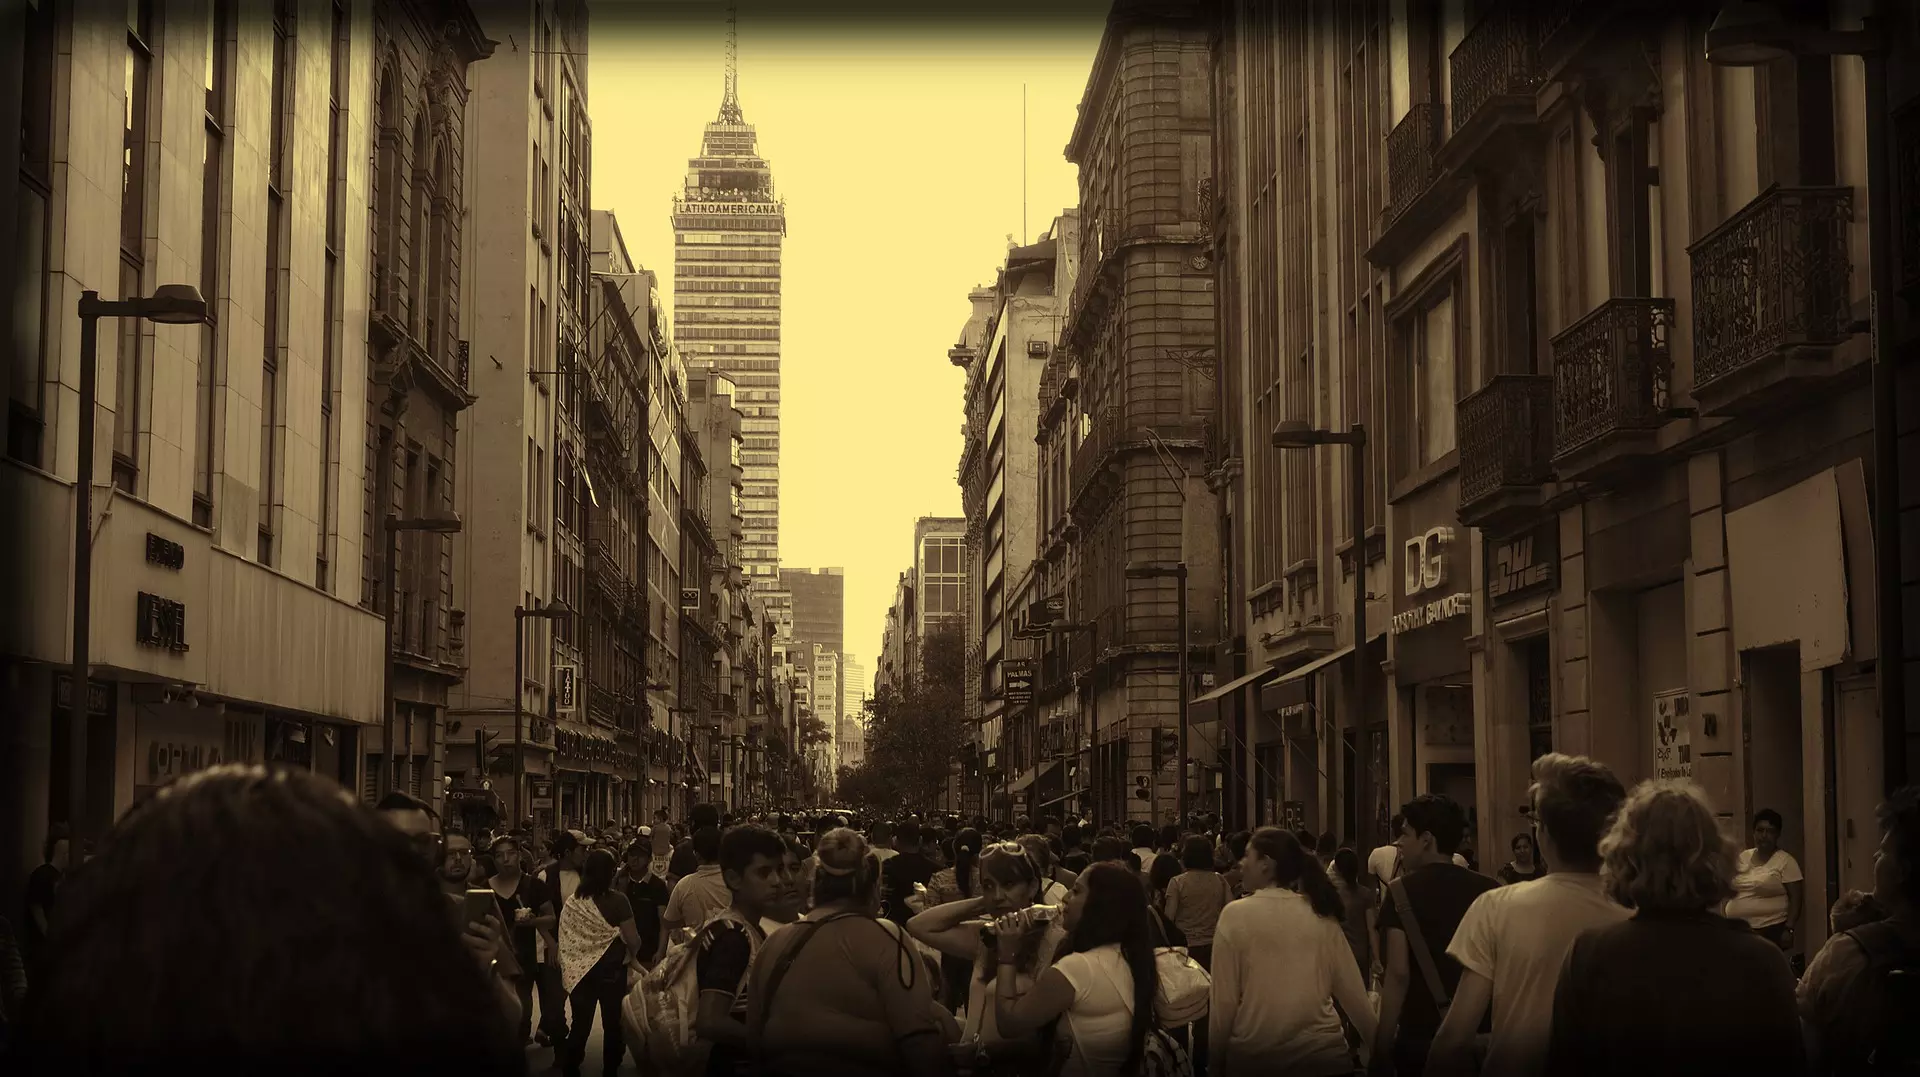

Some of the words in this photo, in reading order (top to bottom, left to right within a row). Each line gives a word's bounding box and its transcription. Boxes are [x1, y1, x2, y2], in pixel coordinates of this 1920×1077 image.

[679, 204, 776, 213] LATINOAMERICANA
[1405, 527, 1449, 596] DG
[1007, 669, 1032, 678] PALMAS
